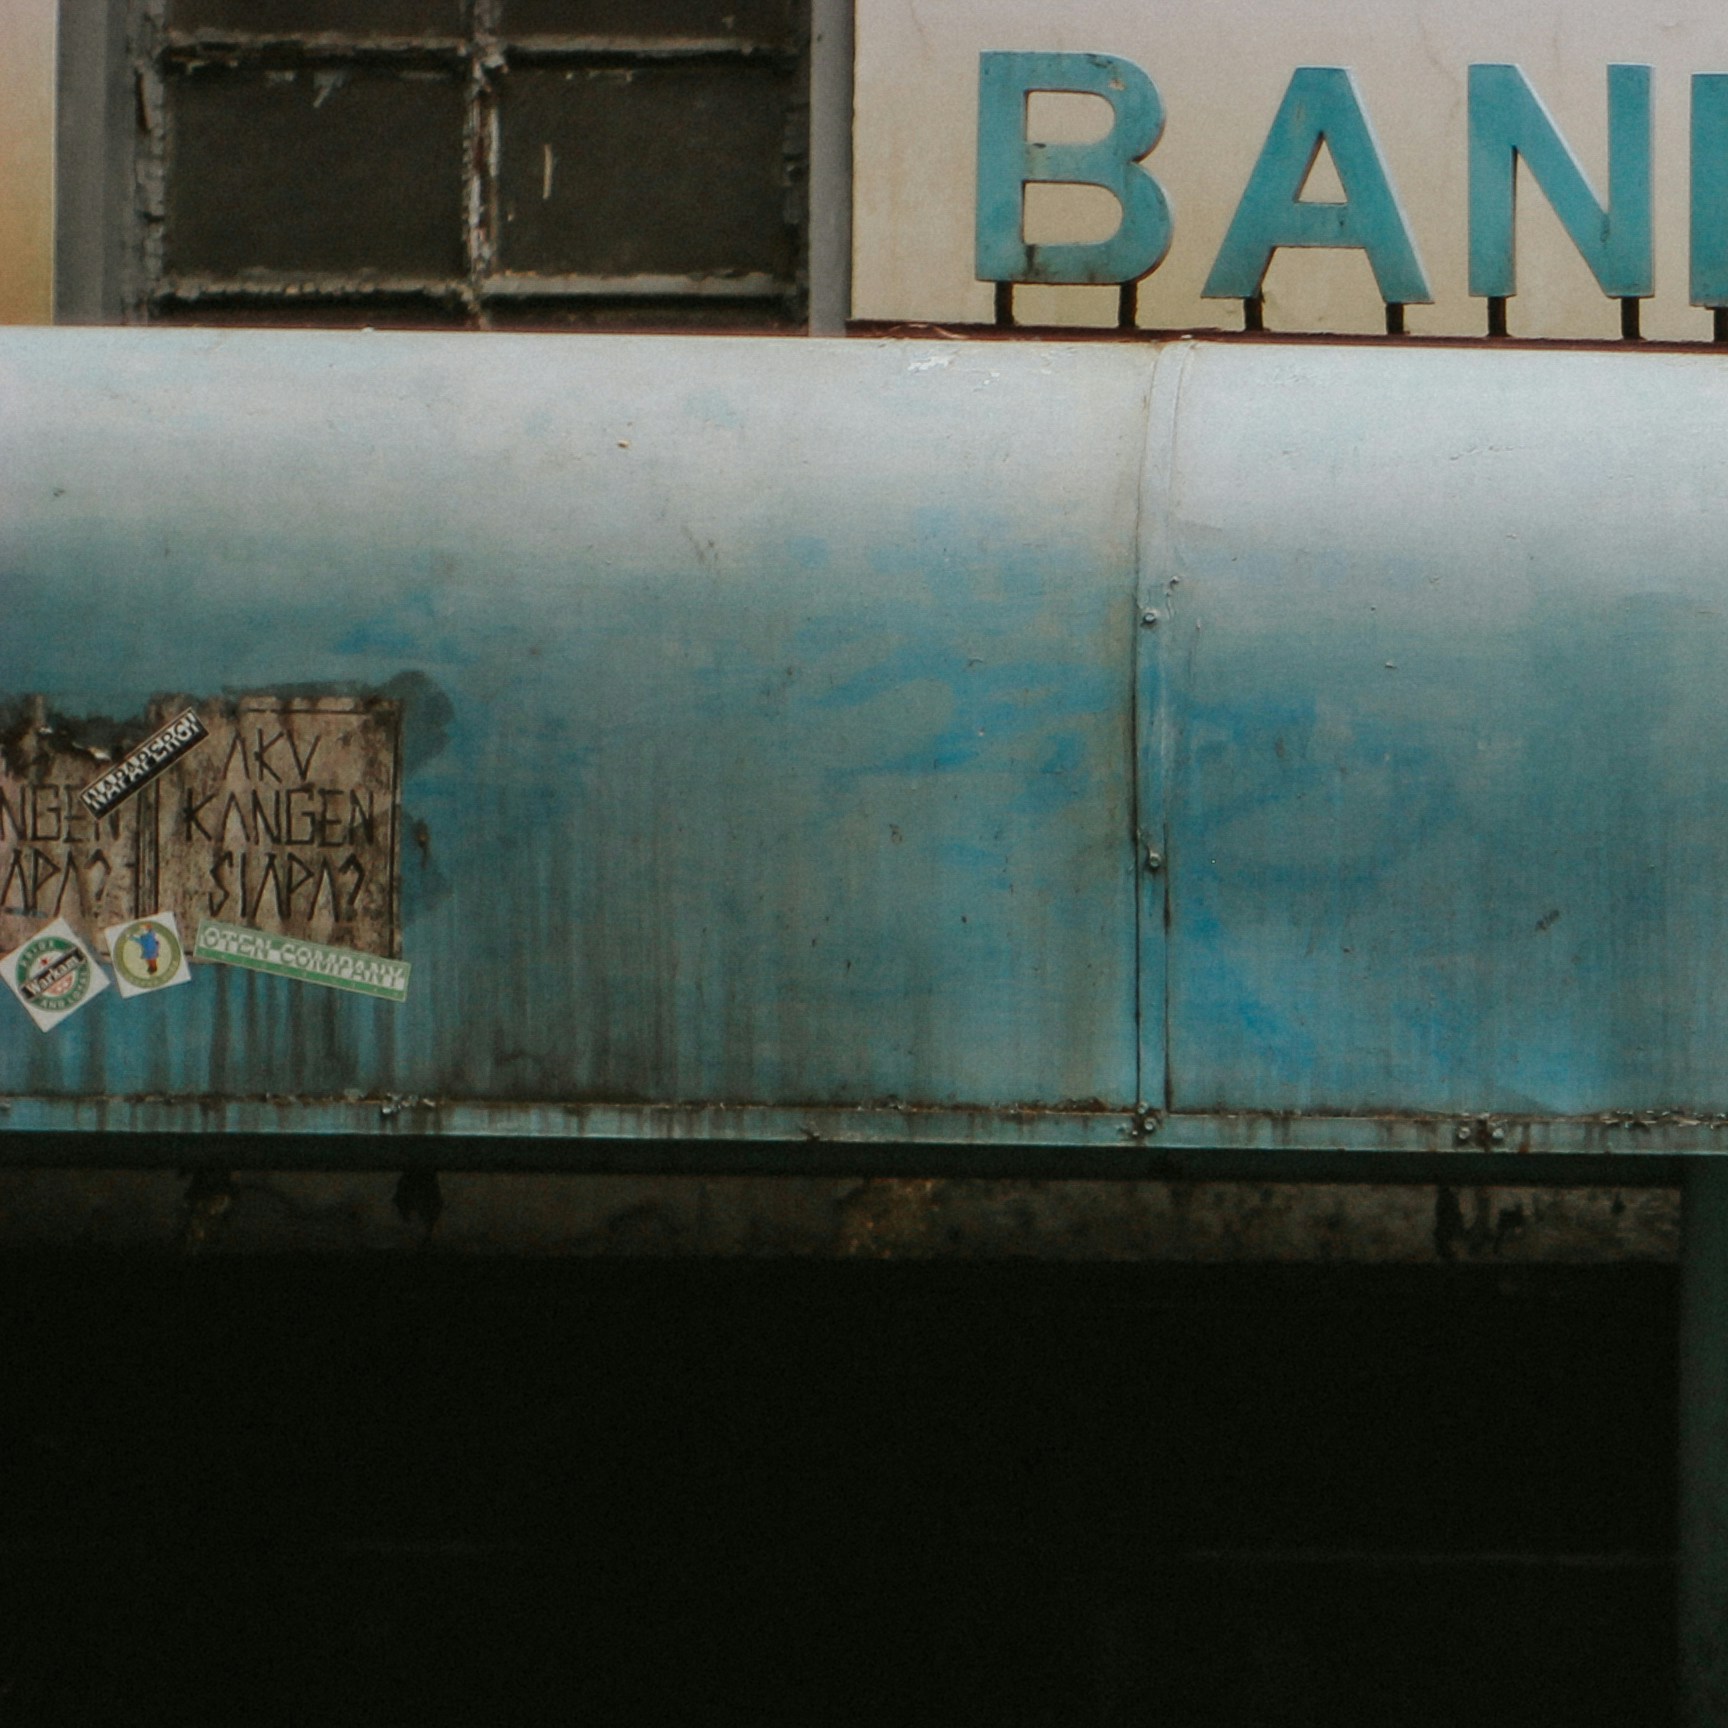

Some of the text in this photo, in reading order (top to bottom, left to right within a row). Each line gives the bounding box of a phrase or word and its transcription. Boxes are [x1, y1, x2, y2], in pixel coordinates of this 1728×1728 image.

[182, 785, 375, 847] KANGEN
[208, 853, 365, 922] SIAPA?
[279, 943, 406, 990] COMPANY
